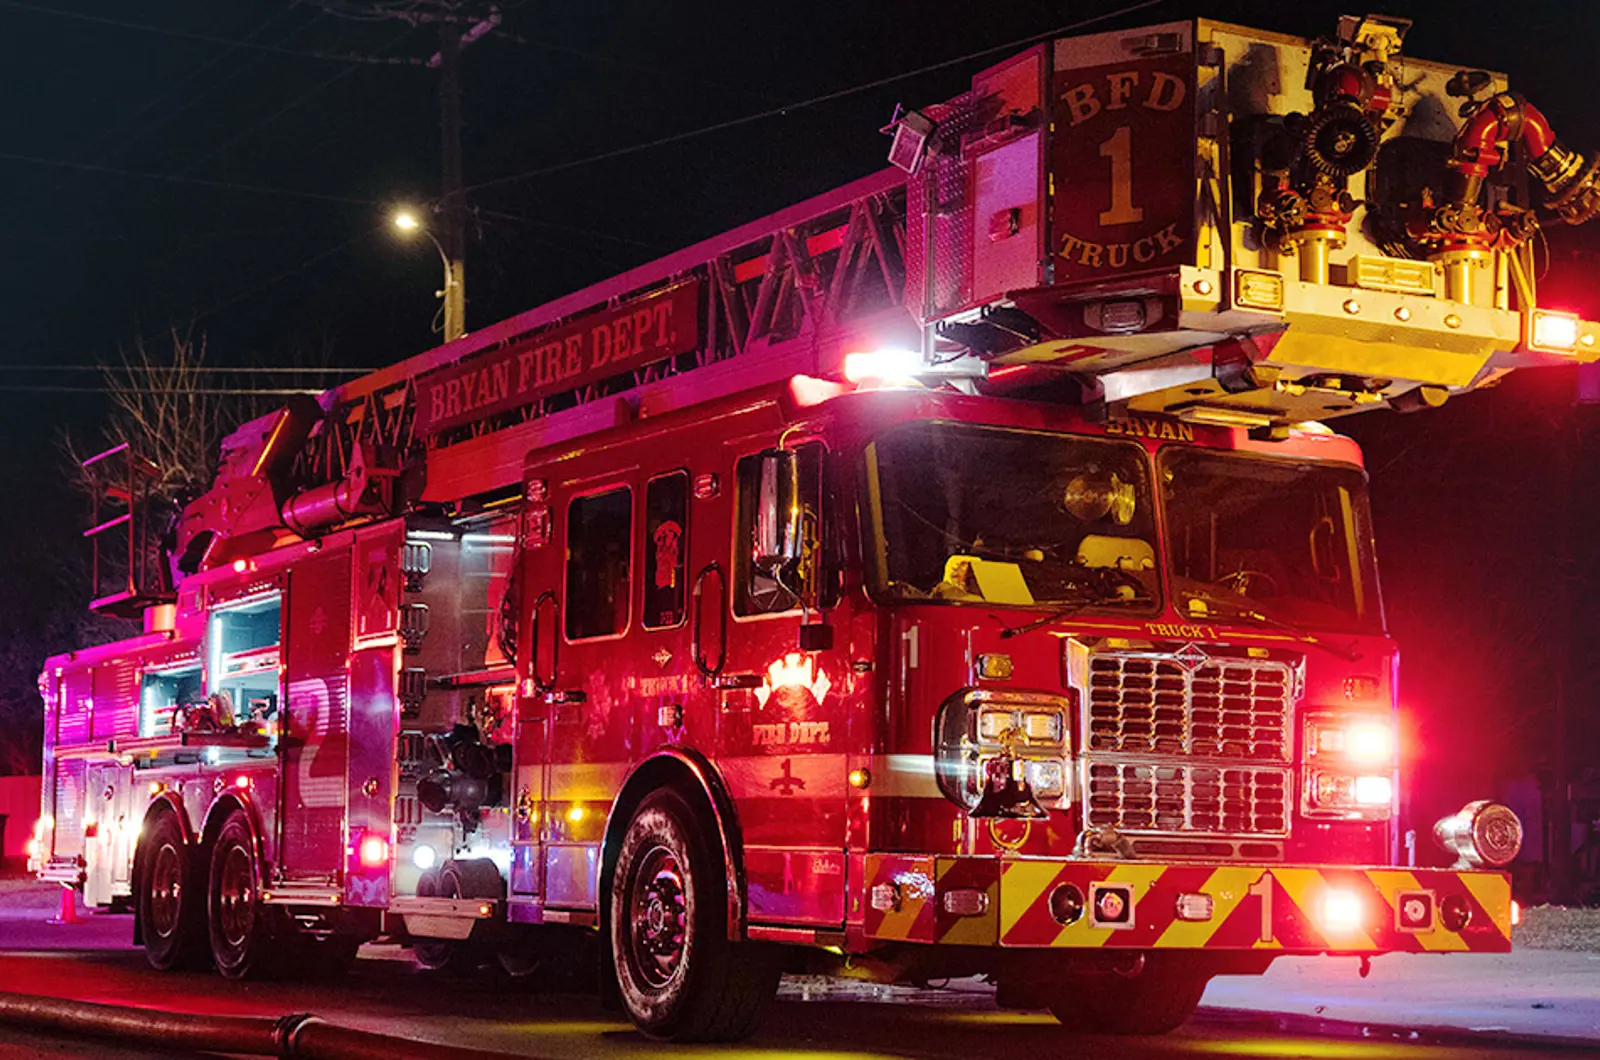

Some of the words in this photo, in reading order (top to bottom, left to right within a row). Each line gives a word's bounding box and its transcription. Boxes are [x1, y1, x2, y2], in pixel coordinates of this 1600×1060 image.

[1060, 71, 1187, 127] BFD
[1099, 126, 1144, 226] 1
[1057, 223, 1184, 268] TRUCK
[429, 359, 511, 423] BRYAN
[517, 333, 582, 393] FIRE
[590, 300, 677, 369] DEPT.
[902, 625, 919, 668] 1
[1145, 623, 1205, 638] TRUCK
[1207, 627, 1218, 639] 1
[1249, 872, 1273, 942] 1
